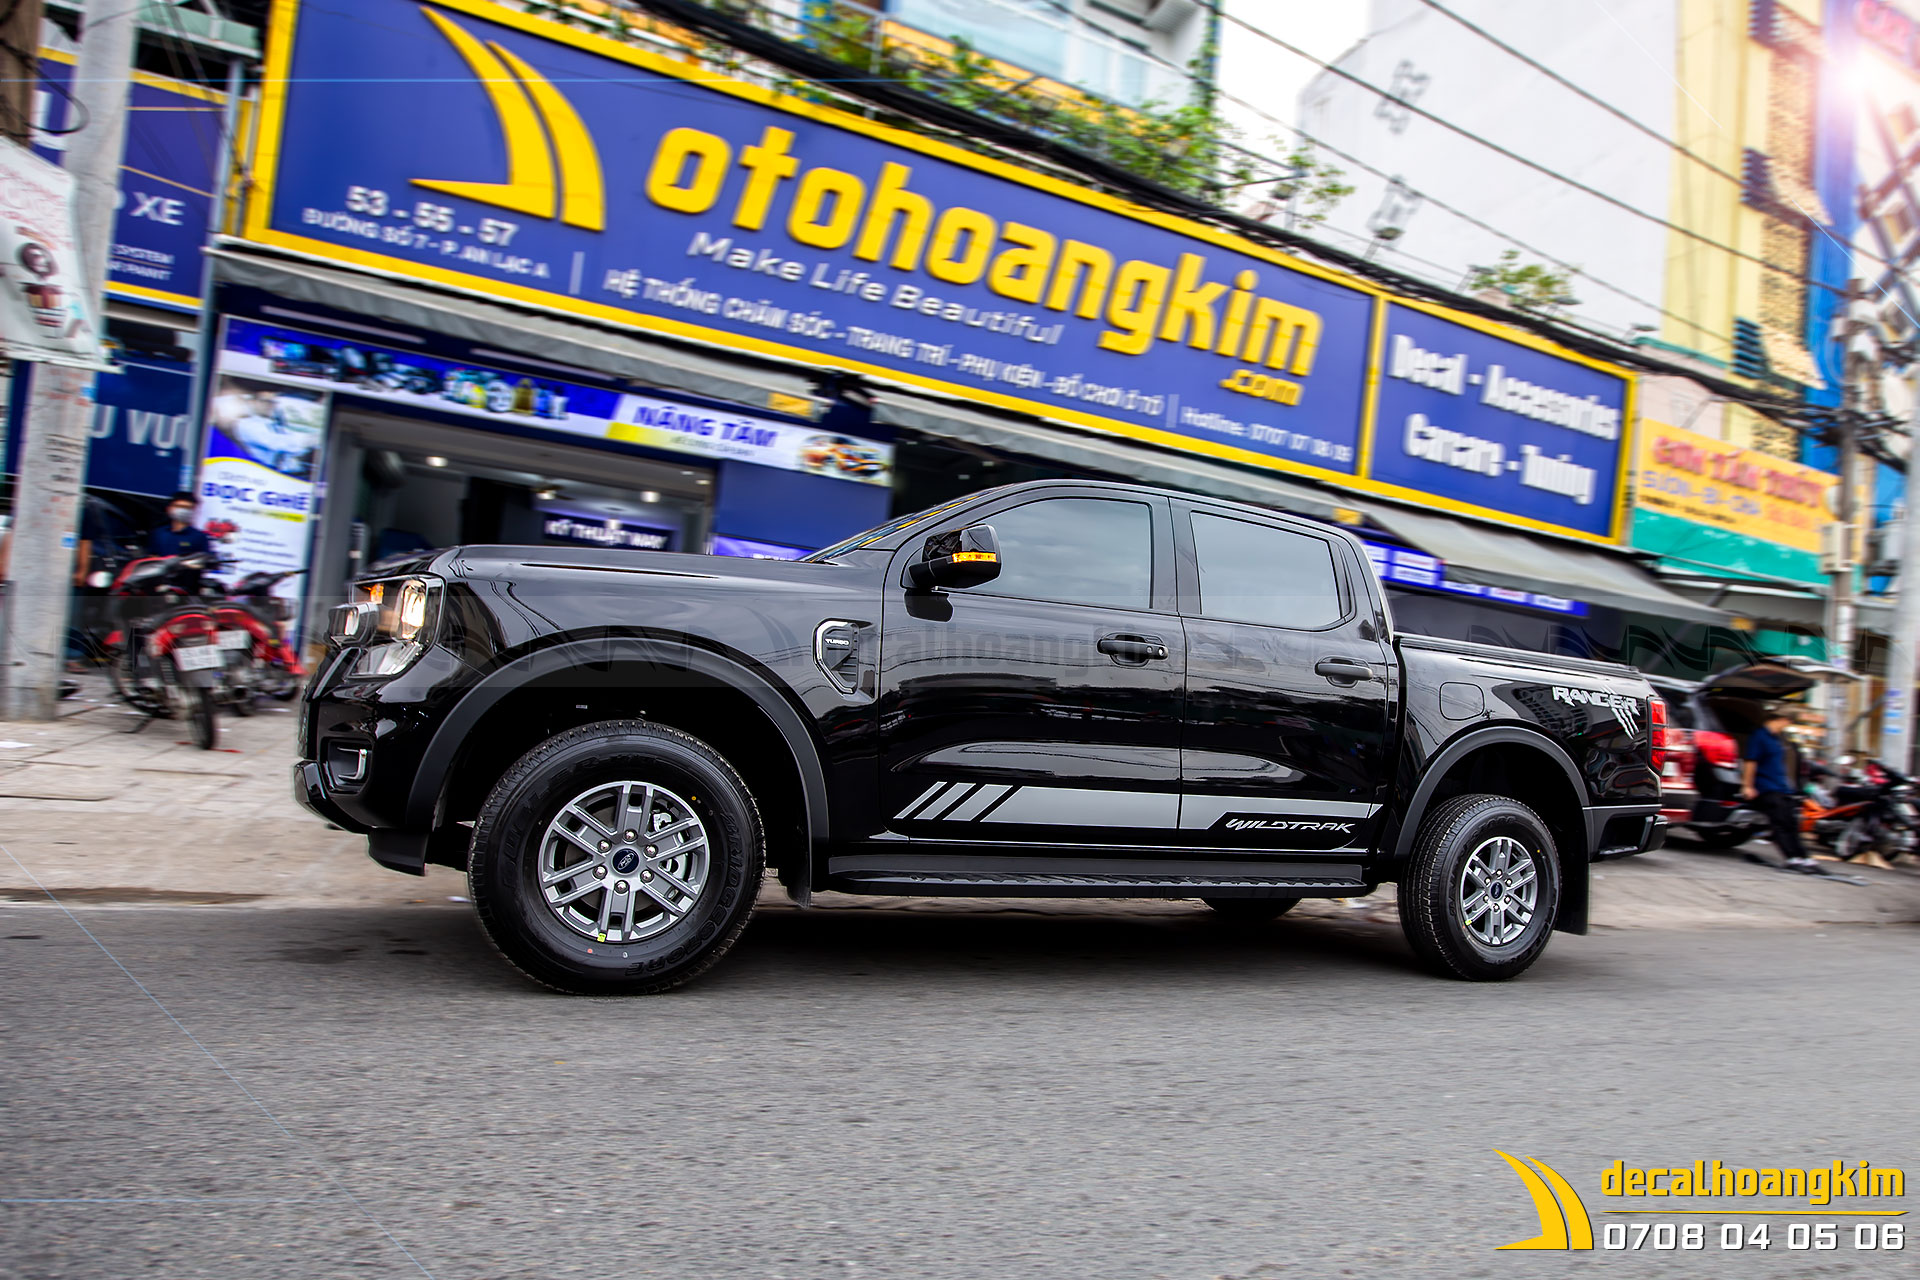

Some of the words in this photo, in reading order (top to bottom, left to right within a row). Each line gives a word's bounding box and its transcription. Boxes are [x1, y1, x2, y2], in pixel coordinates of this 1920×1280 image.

[130, 192, 186, 226] XE
[346, 185, 389, 216] 53
[413, 202, 455, 232] 55
[478, 217, 519, 246] 57
[414, 234, 430, 249] 7
[532, 263, 550, 278] A
[646, 126, 1323, 376] otohoangkim
[687, 231, 806, 282] Make
[810, 263, 888, 302] Life
[889, 284, 1064, 345] Beautiful
[603, 269, 641, 299] HỆ
[643, 277, 722, 314] THỐNG
[788, 311, 836, 340] SÓC
[846, 326, 915, 358] TRANG
[915, 343, 954, 366] TRÍ
[957, 353, 997, 381] PHỤ
[1388, 334, 1468, 395] Decal
[1219, 369, 1303, 405] .com
[202, 483, 256, 503] BỌC
[824, 638, 850, 646] TURBO
[1552, 686, 1640, 716] RANGER
[1225, 818, 1356, 833] WILDTRAK
